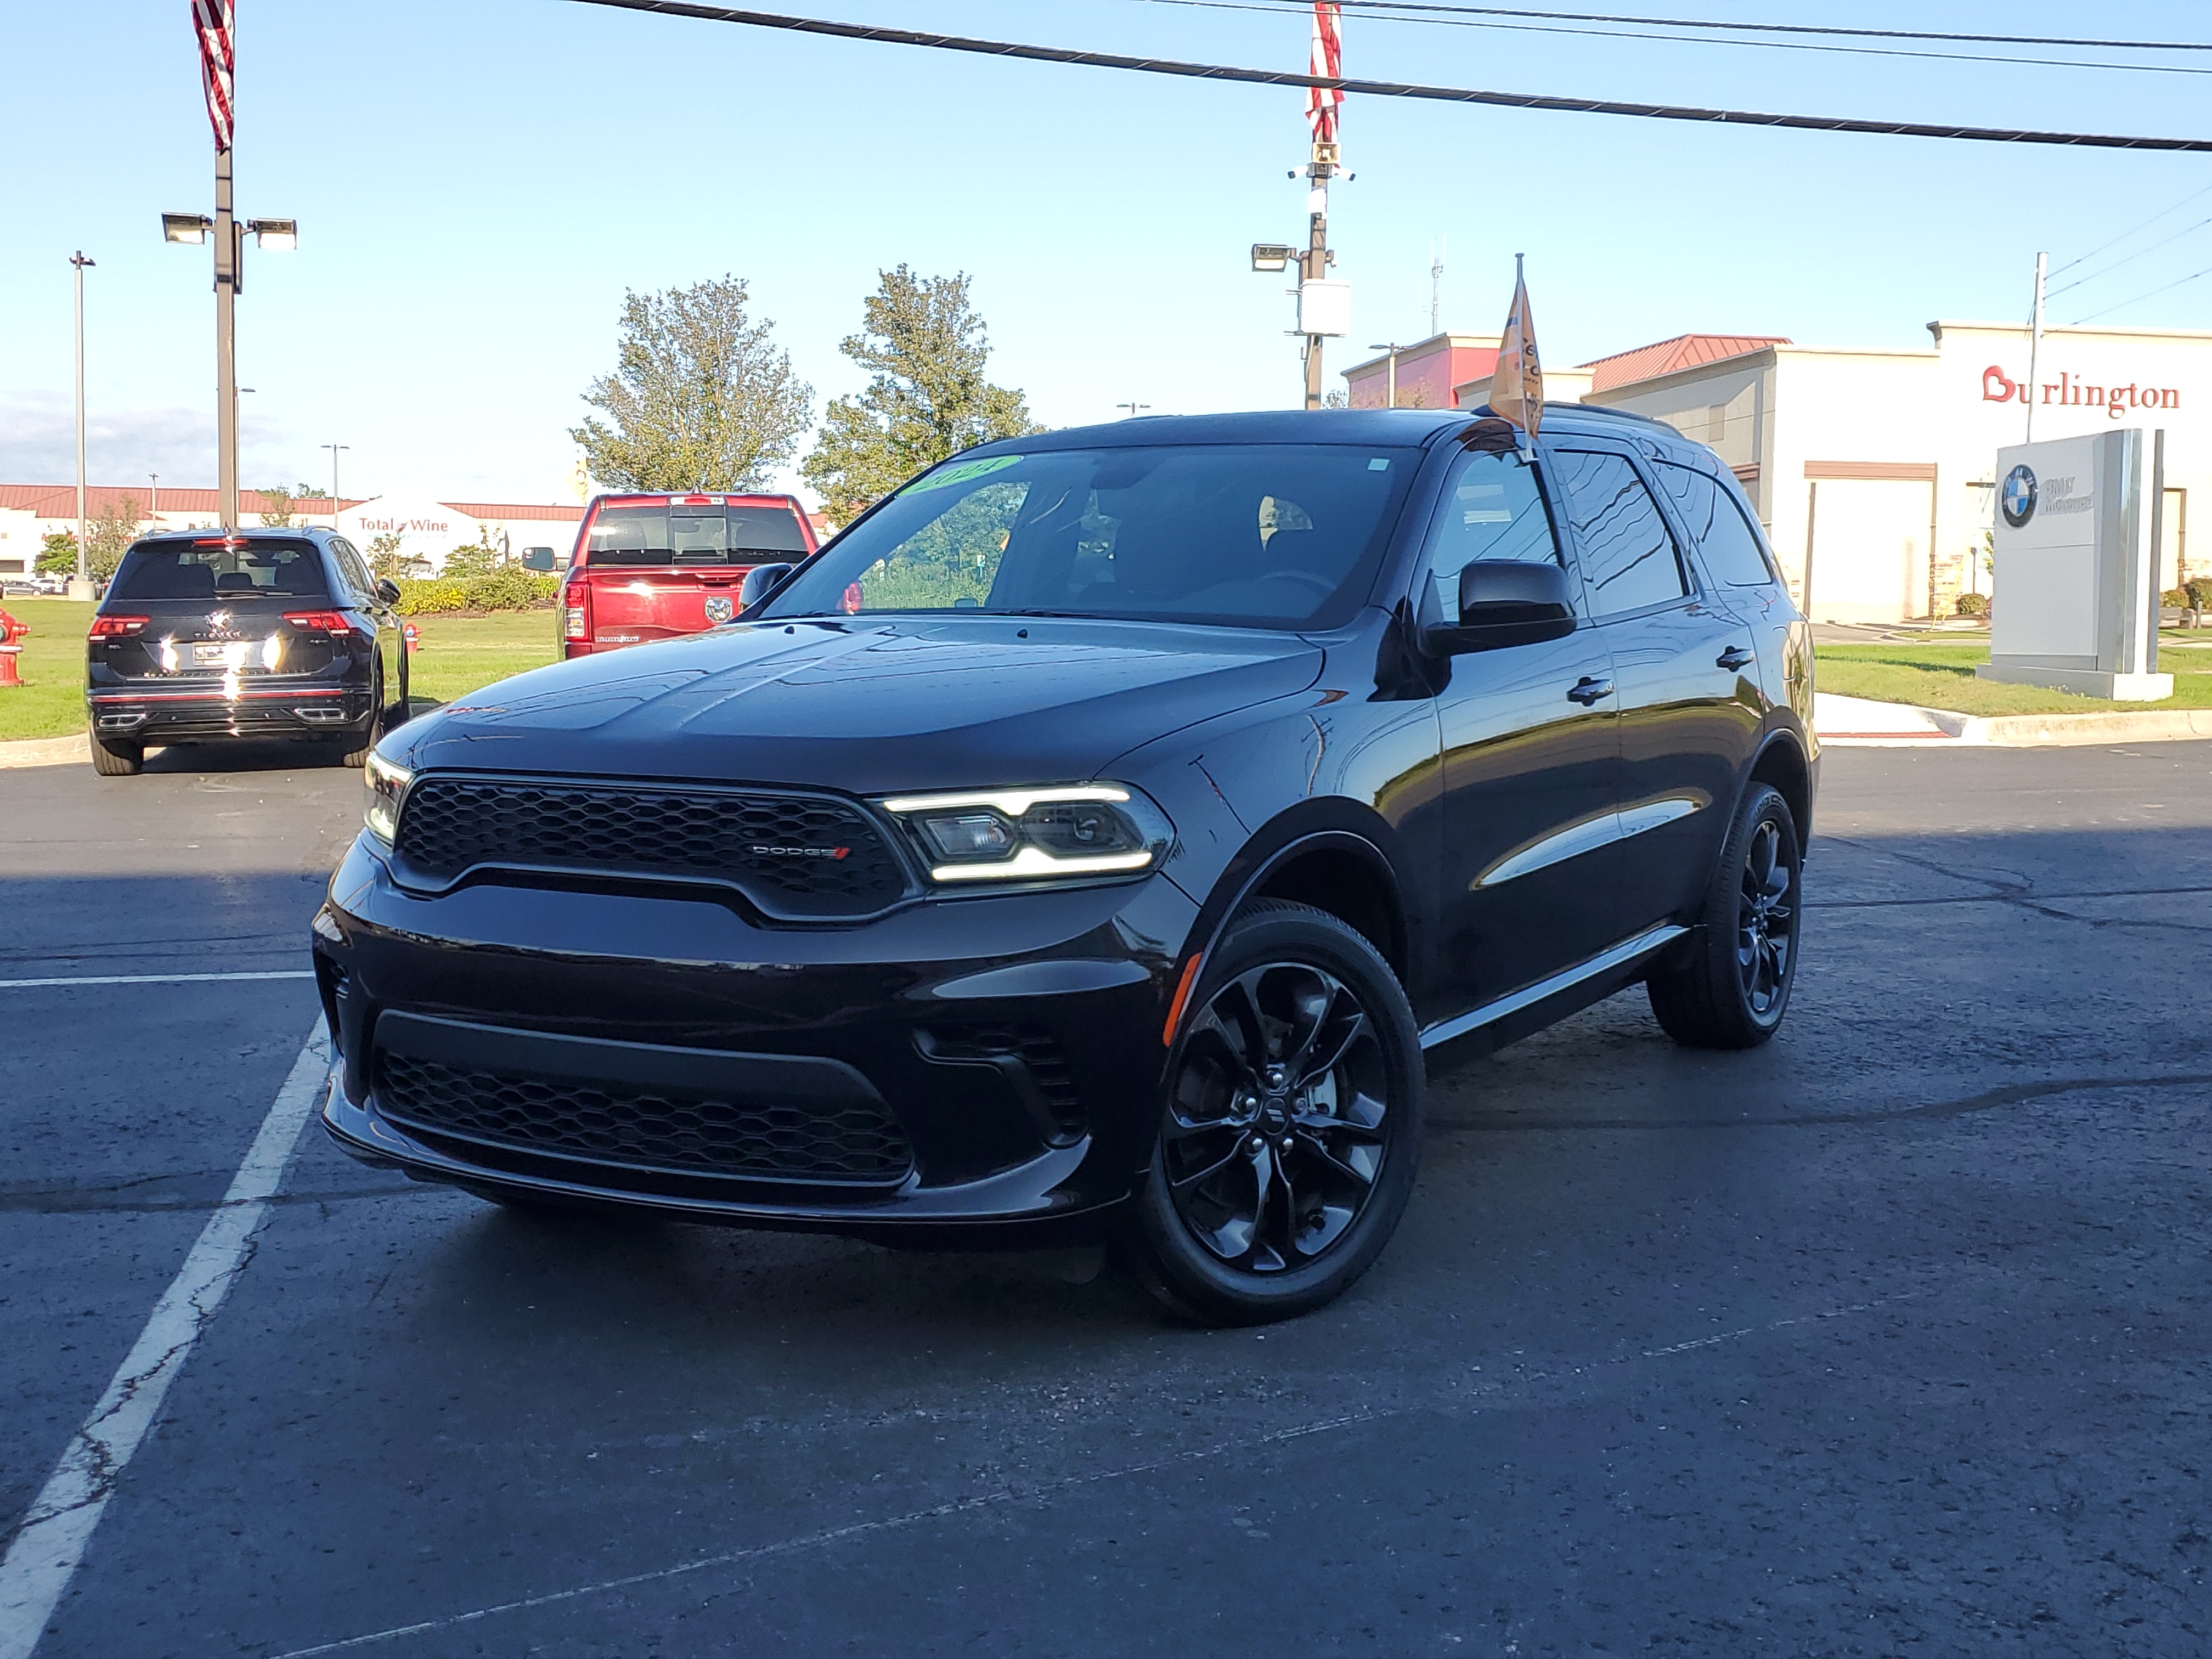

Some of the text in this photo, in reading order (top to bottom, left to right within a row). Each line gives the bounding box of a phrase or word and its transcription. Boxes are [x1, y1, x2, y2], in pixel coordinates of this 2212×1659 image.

[1982, 365, 2180, 419] Burlington
[359, 517, 448, 532] Total Wine
[753, 846, 837, 856] DODGE
